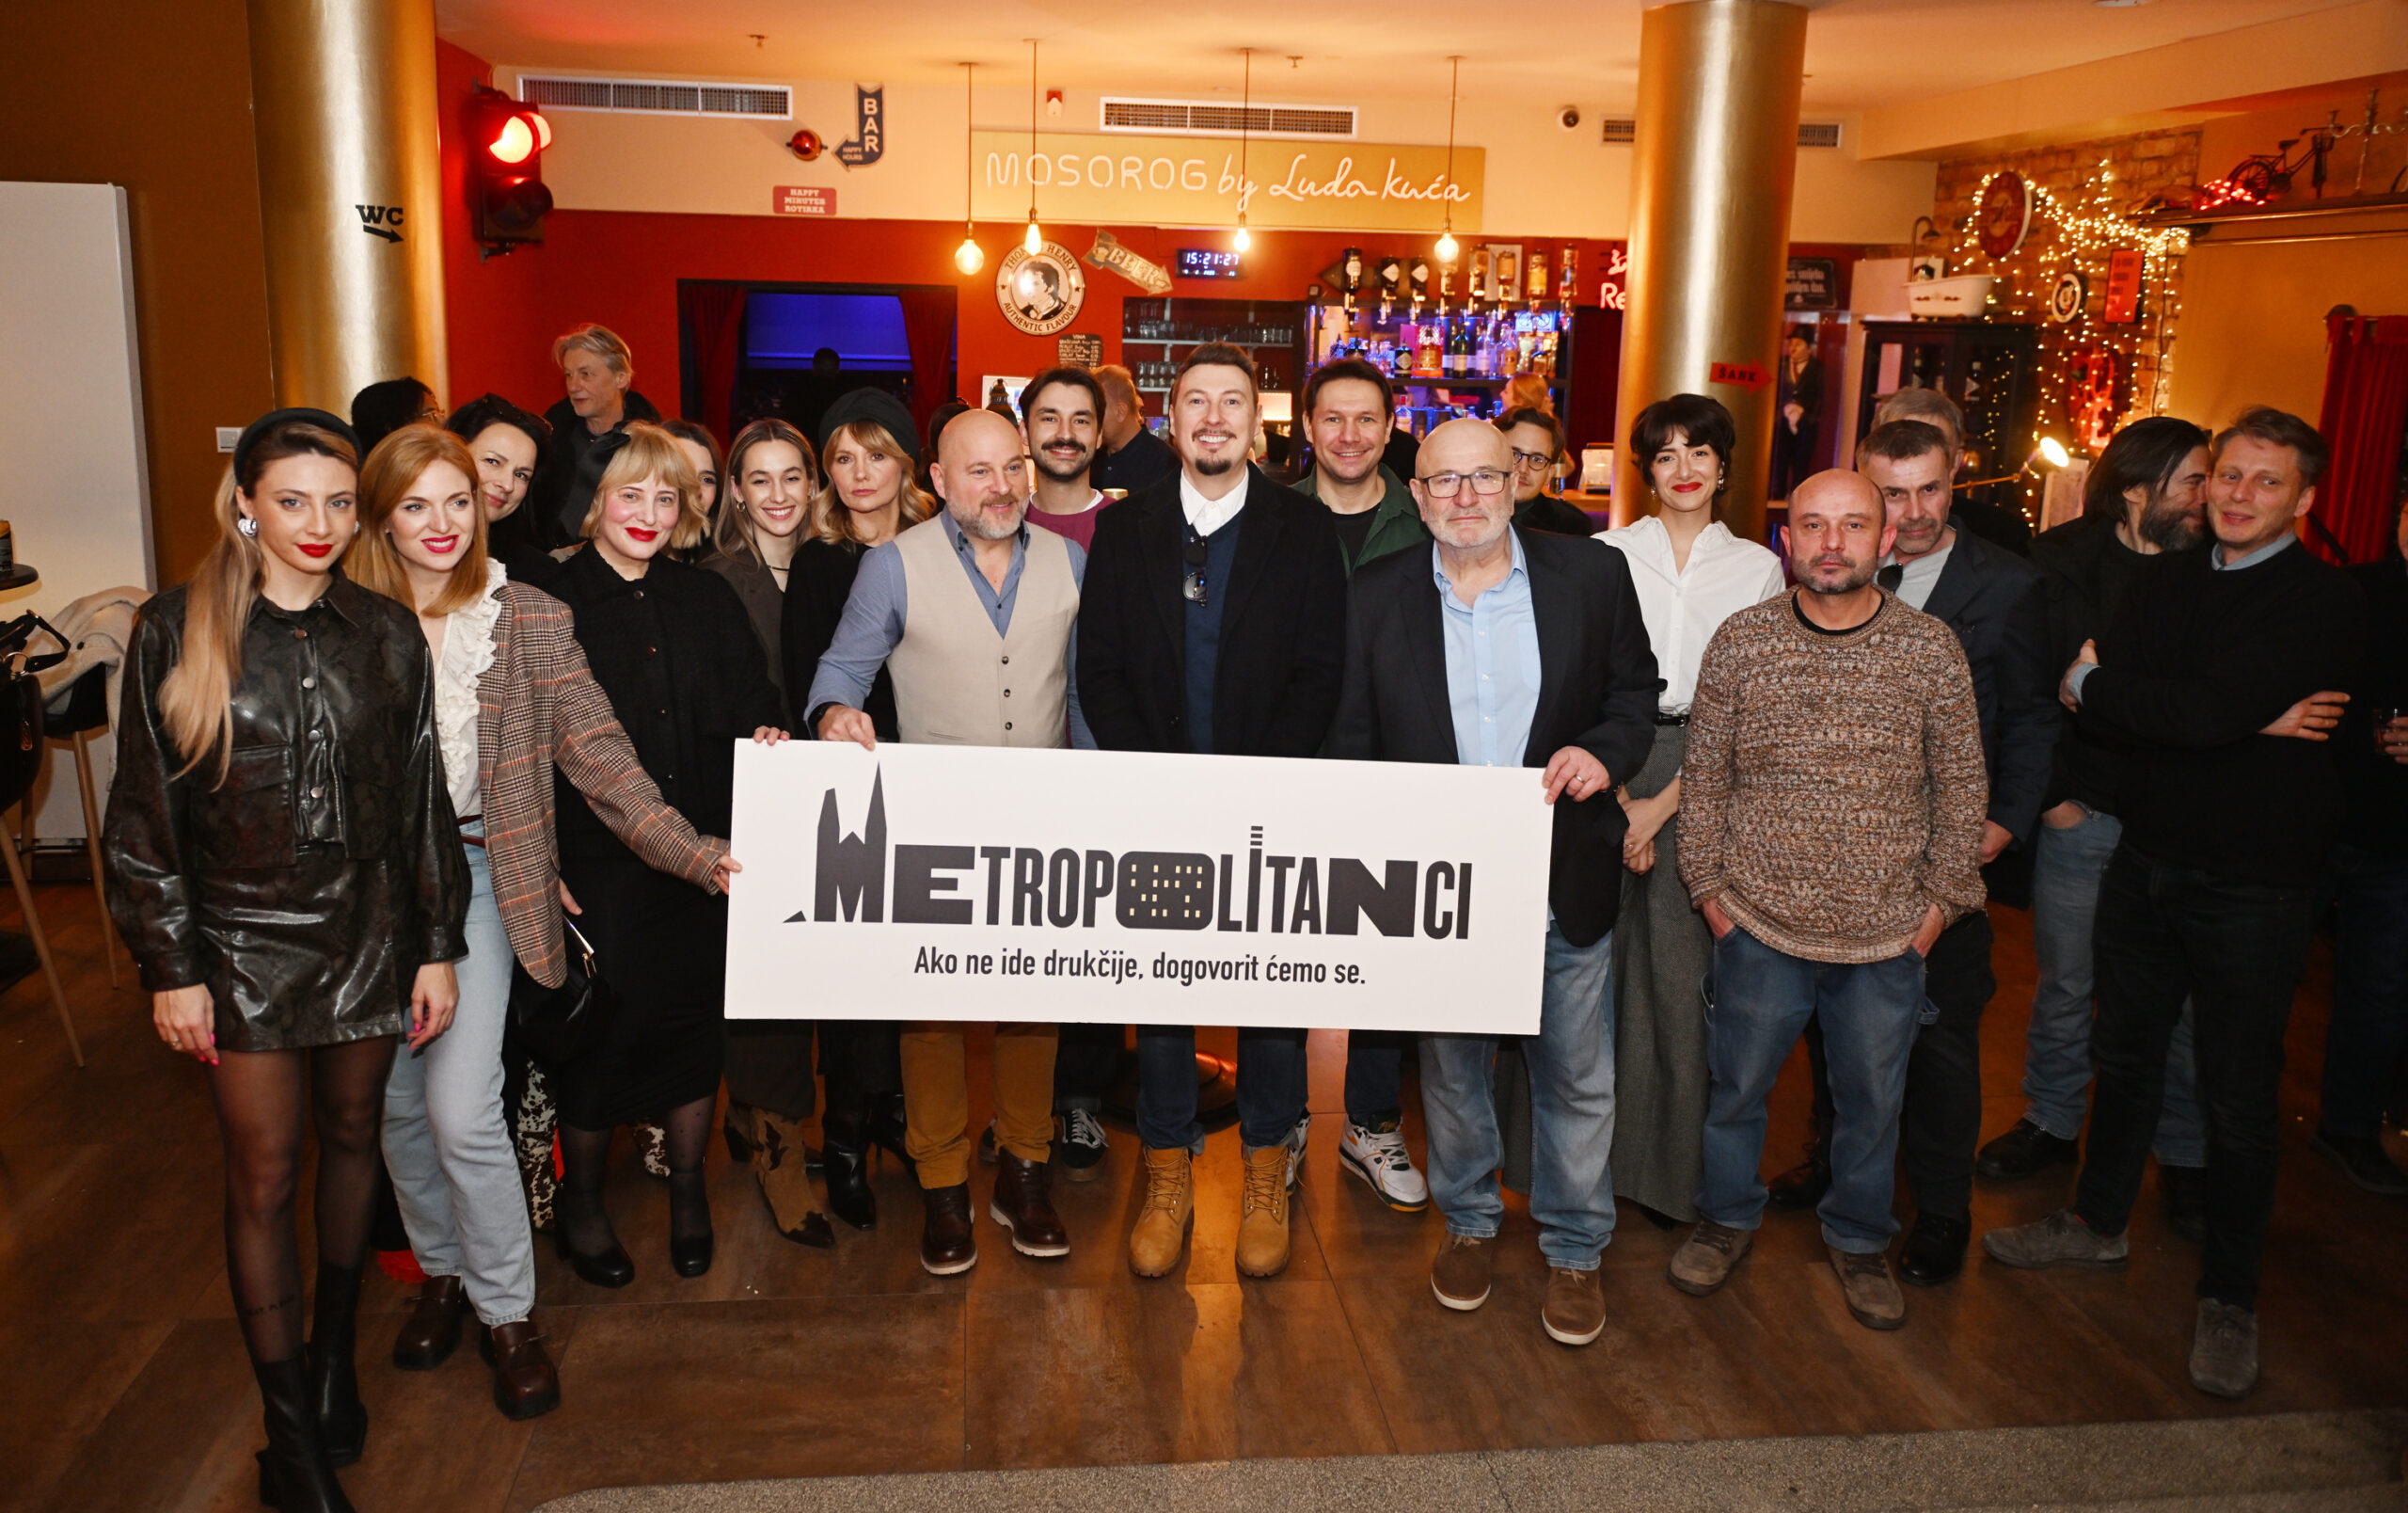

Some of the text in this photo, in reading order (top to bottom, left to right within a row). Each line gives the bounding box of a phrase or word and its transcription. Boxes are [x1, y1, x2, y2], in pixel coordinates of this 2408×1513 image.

[863, 97, 879, 152] BAR
[790, 188, 820, 197] HAPPY
[986, 151, 1208, 192] MOSOROG
[1217, 153, 1259, 212] by
[1269, 153, 1377, 201] Luda
[355, 204, 404, 226] WC
[1047, 245, 1077, 271] HENRY
[1108, 247, 1159, 285] BEER
[1186, 251, 1240, 266] 15:21:27
[1004, 302, 1077, 332] AUTHENTIC FLAVOUR
[784, 760, 1473, 940] METROPOLITANCI
[914, 946, 1367, 987] Ako ne ide drukčije, dogovorit ćemo se.
